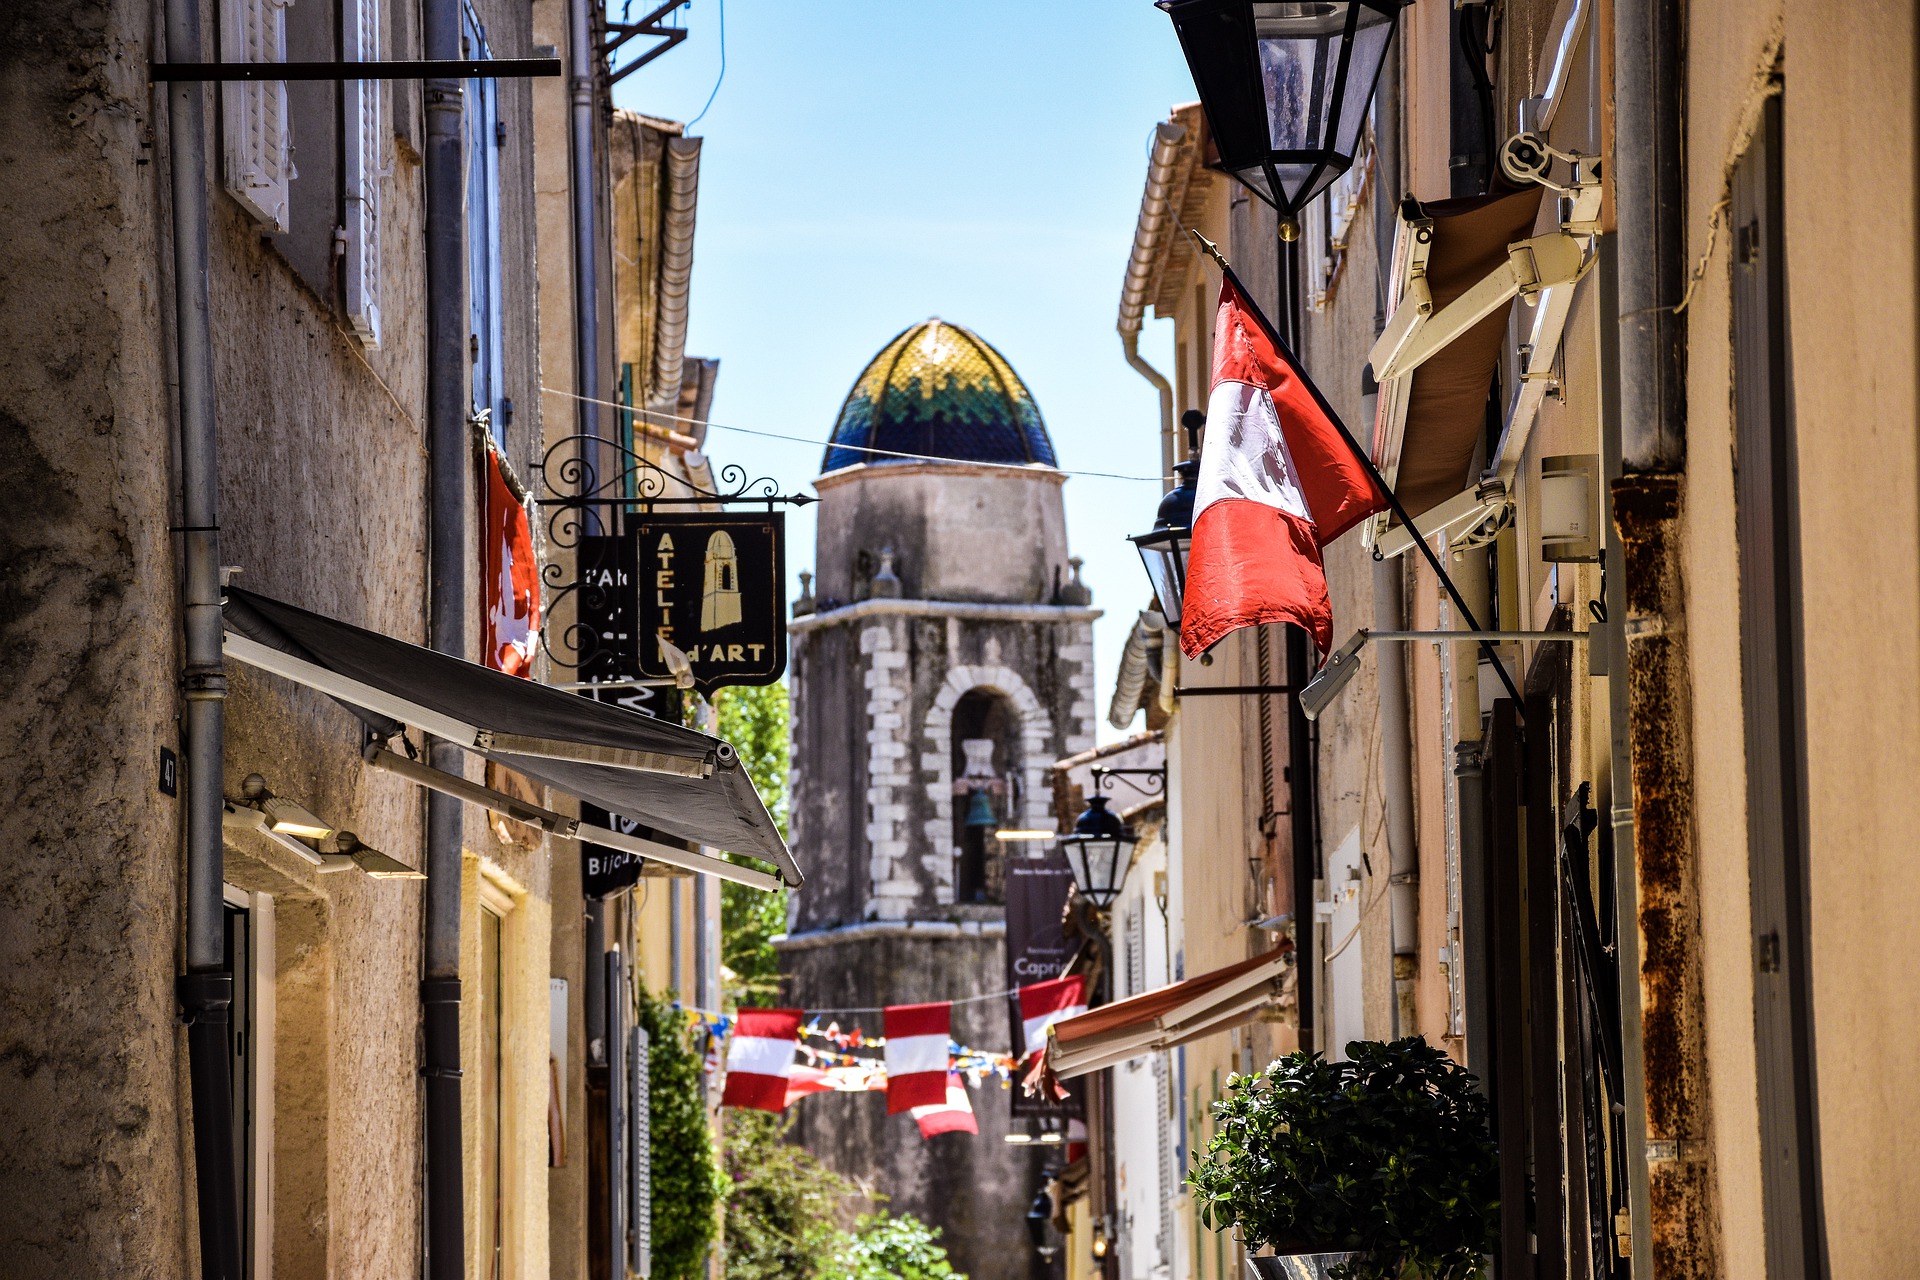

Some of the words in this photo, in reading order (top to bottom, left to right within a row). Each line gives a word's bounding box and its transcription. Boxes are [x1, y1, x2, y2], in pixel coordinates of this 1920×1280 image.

[657, 532, 675, 663] ATELIE
[686, 643, 766, 662] d'ART
[164, 758, 174, 788] 47
[588, 852, 643, 876] Bijoux
